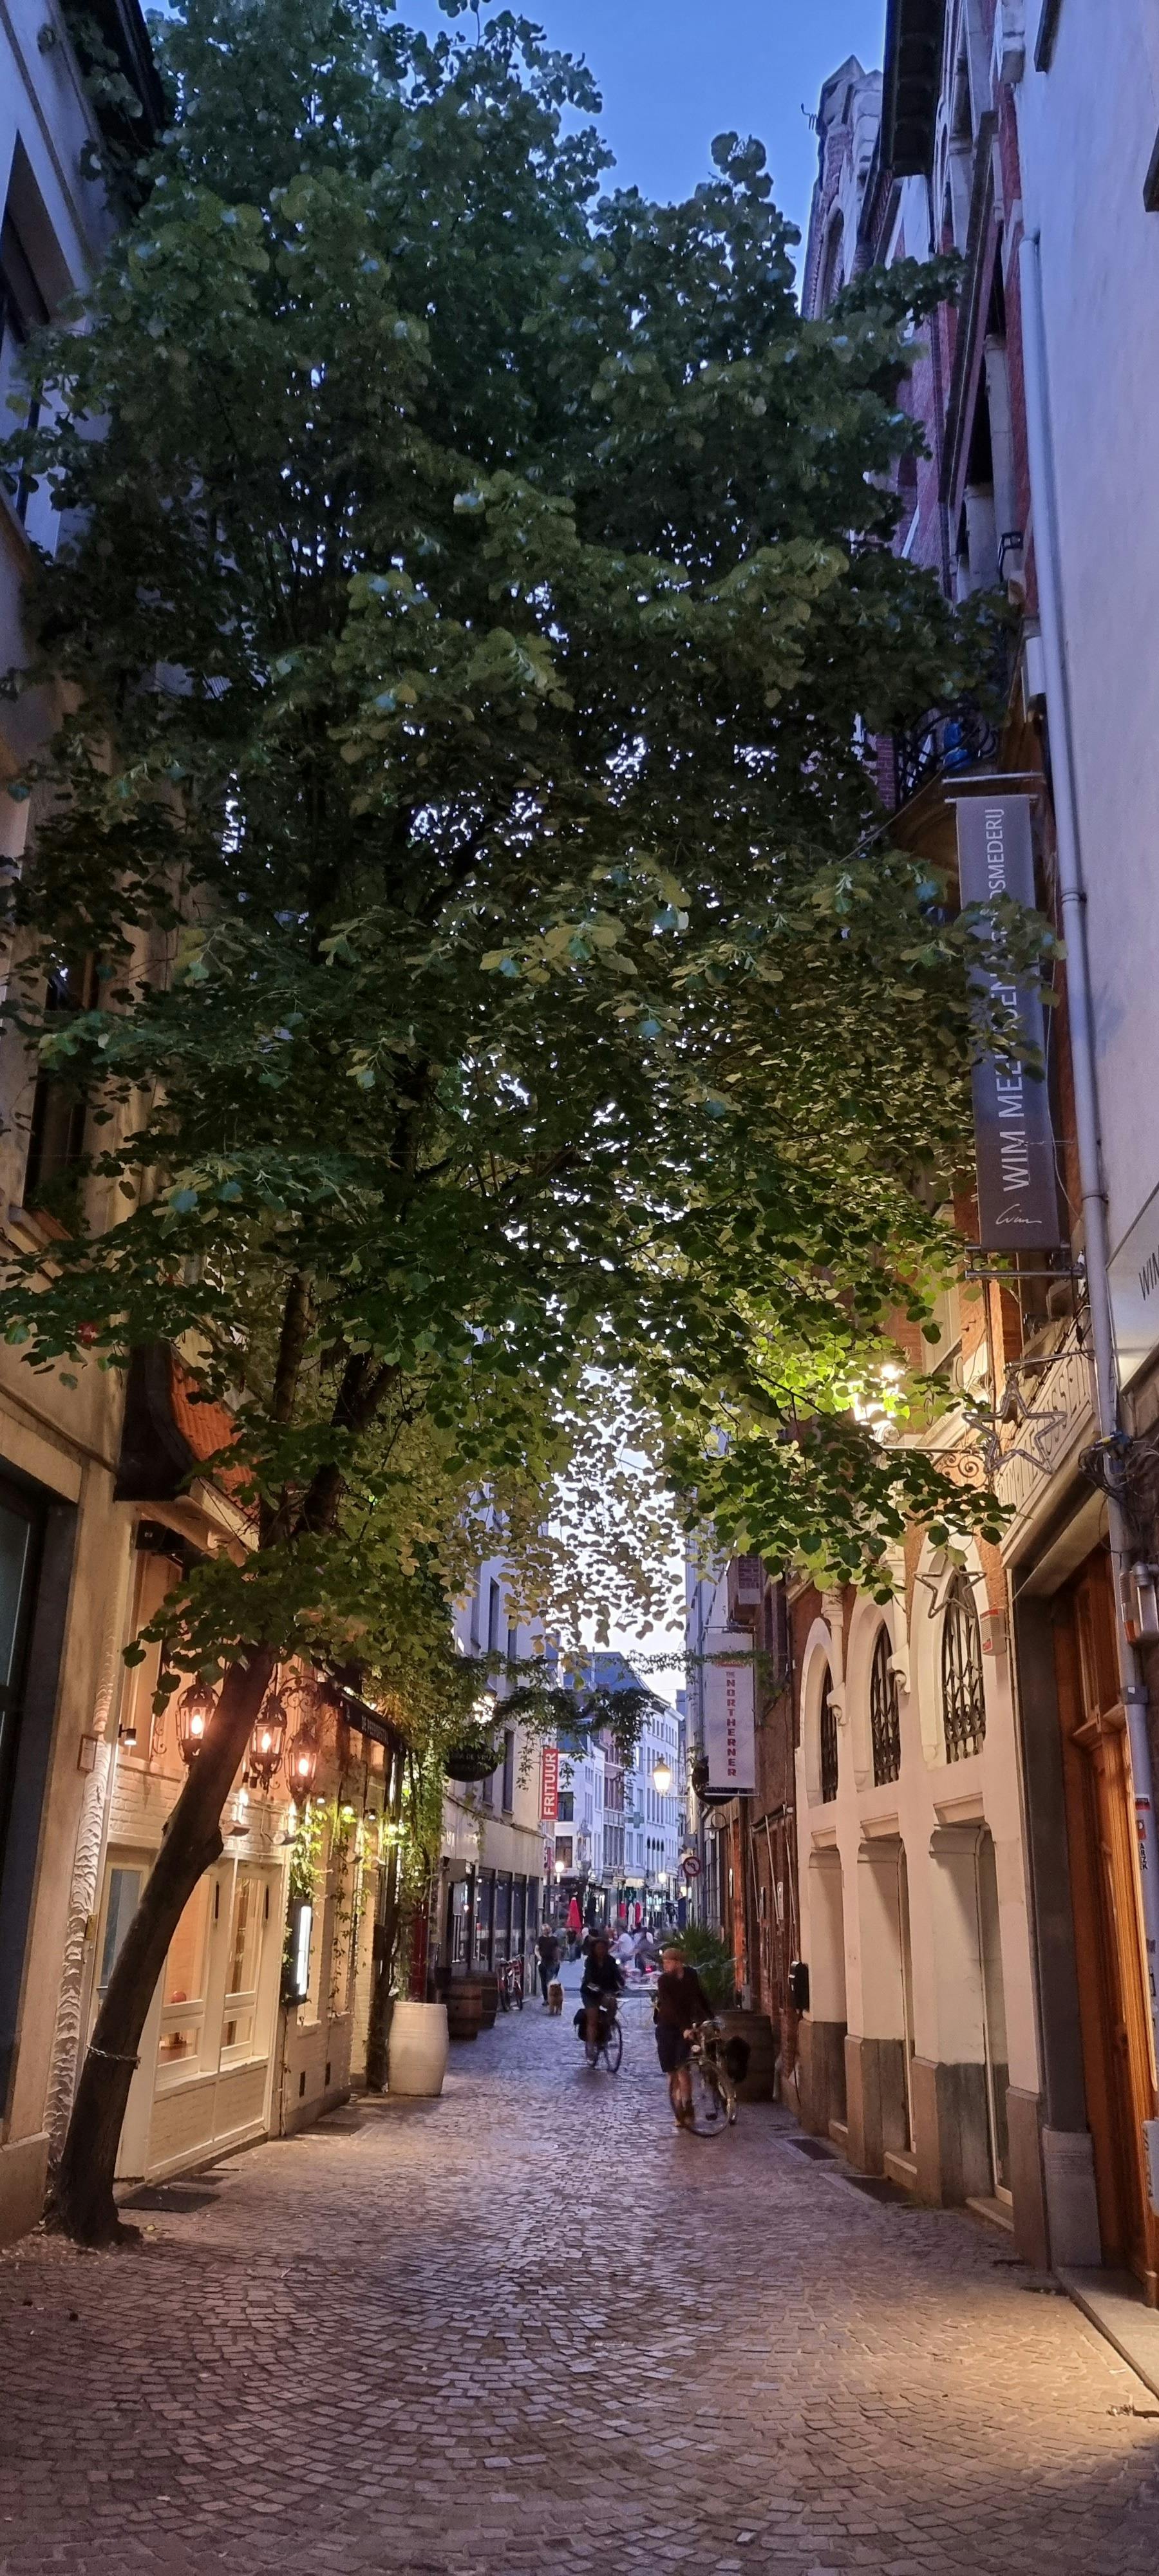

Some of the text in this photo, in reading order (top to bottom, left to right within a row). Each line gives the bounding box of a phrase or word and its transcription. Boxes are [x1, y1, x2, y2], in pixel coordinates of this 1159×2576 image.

[999, 1130, 1030, 1192] WIM
[726, 1679, 737, 1776] NORTHERNER
[543, 1752, 556, 1815] FRITUUR
